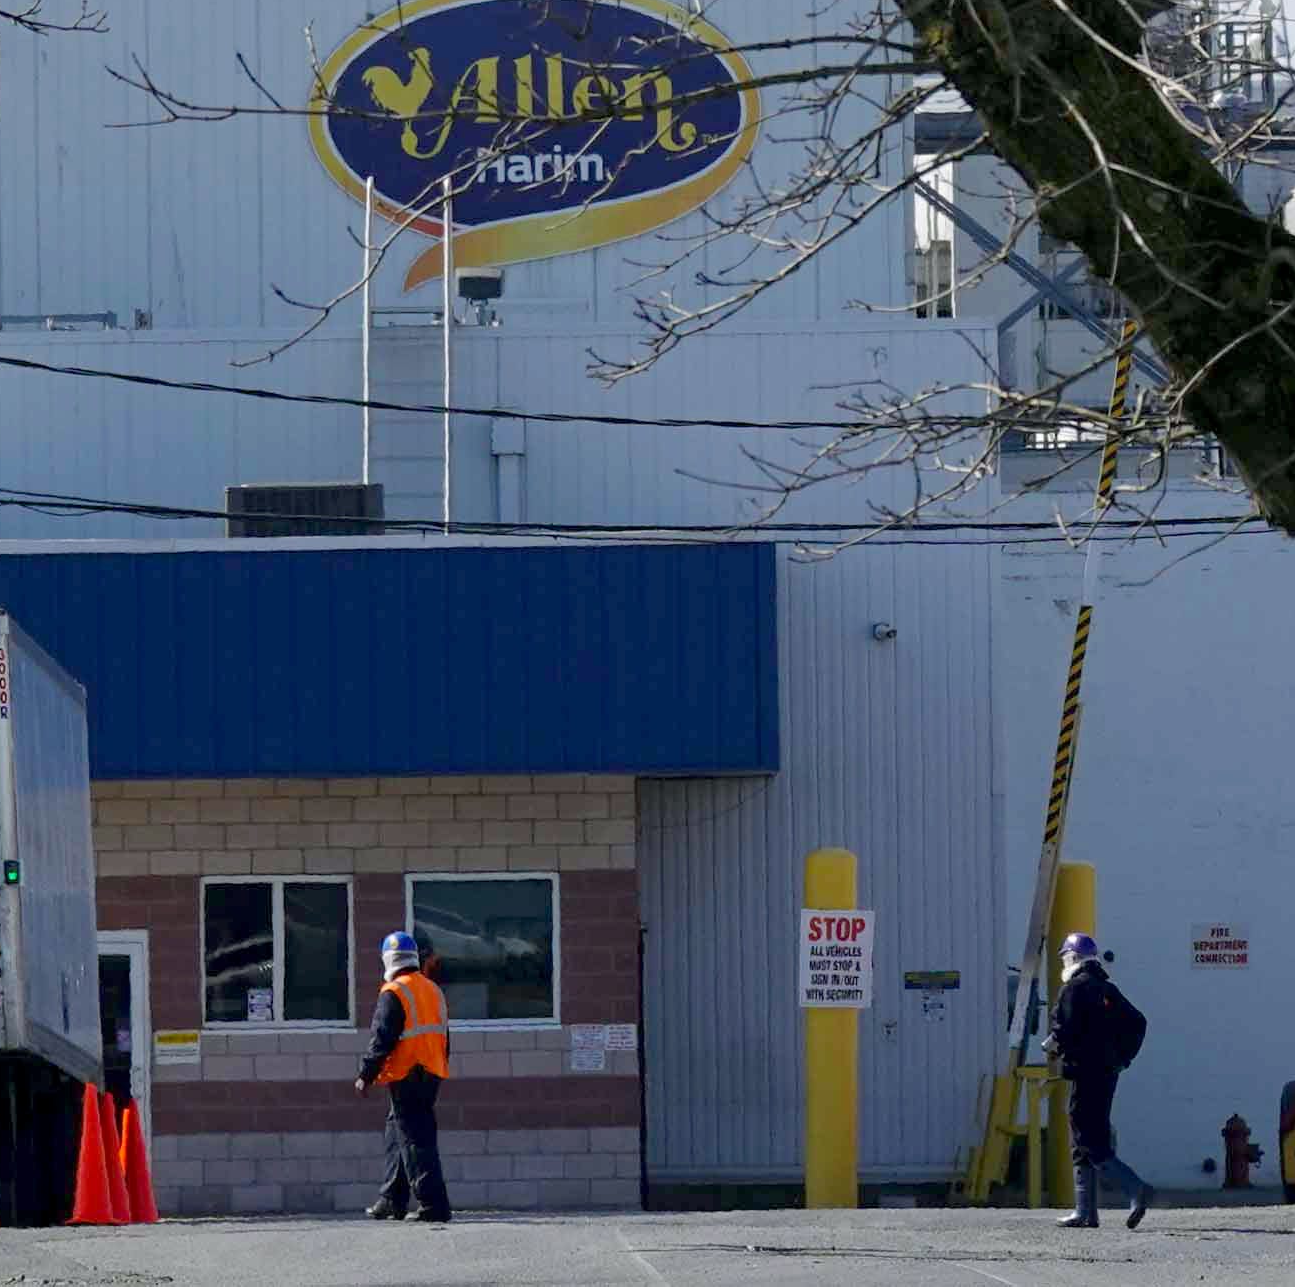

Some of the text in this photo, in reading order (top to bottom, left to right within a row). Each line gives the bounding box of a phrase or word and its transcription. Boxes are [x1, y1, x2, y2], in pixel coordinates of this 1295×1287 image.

[402, 51, 698, 159] Allen
[475, 145, 605, 184] Harim
[809, 917, 865, 942] STOP
[1210, 928, 1230, 938] FIRE
[810, 945, 862, 957] ALL VEHICLES
[810, 961, 831, 970] MUST
[833, 961, 852, 971] STOP
[811, 974, 828, 985] SIGN
[806, 989, 863, 1001] WITH SECURITY
